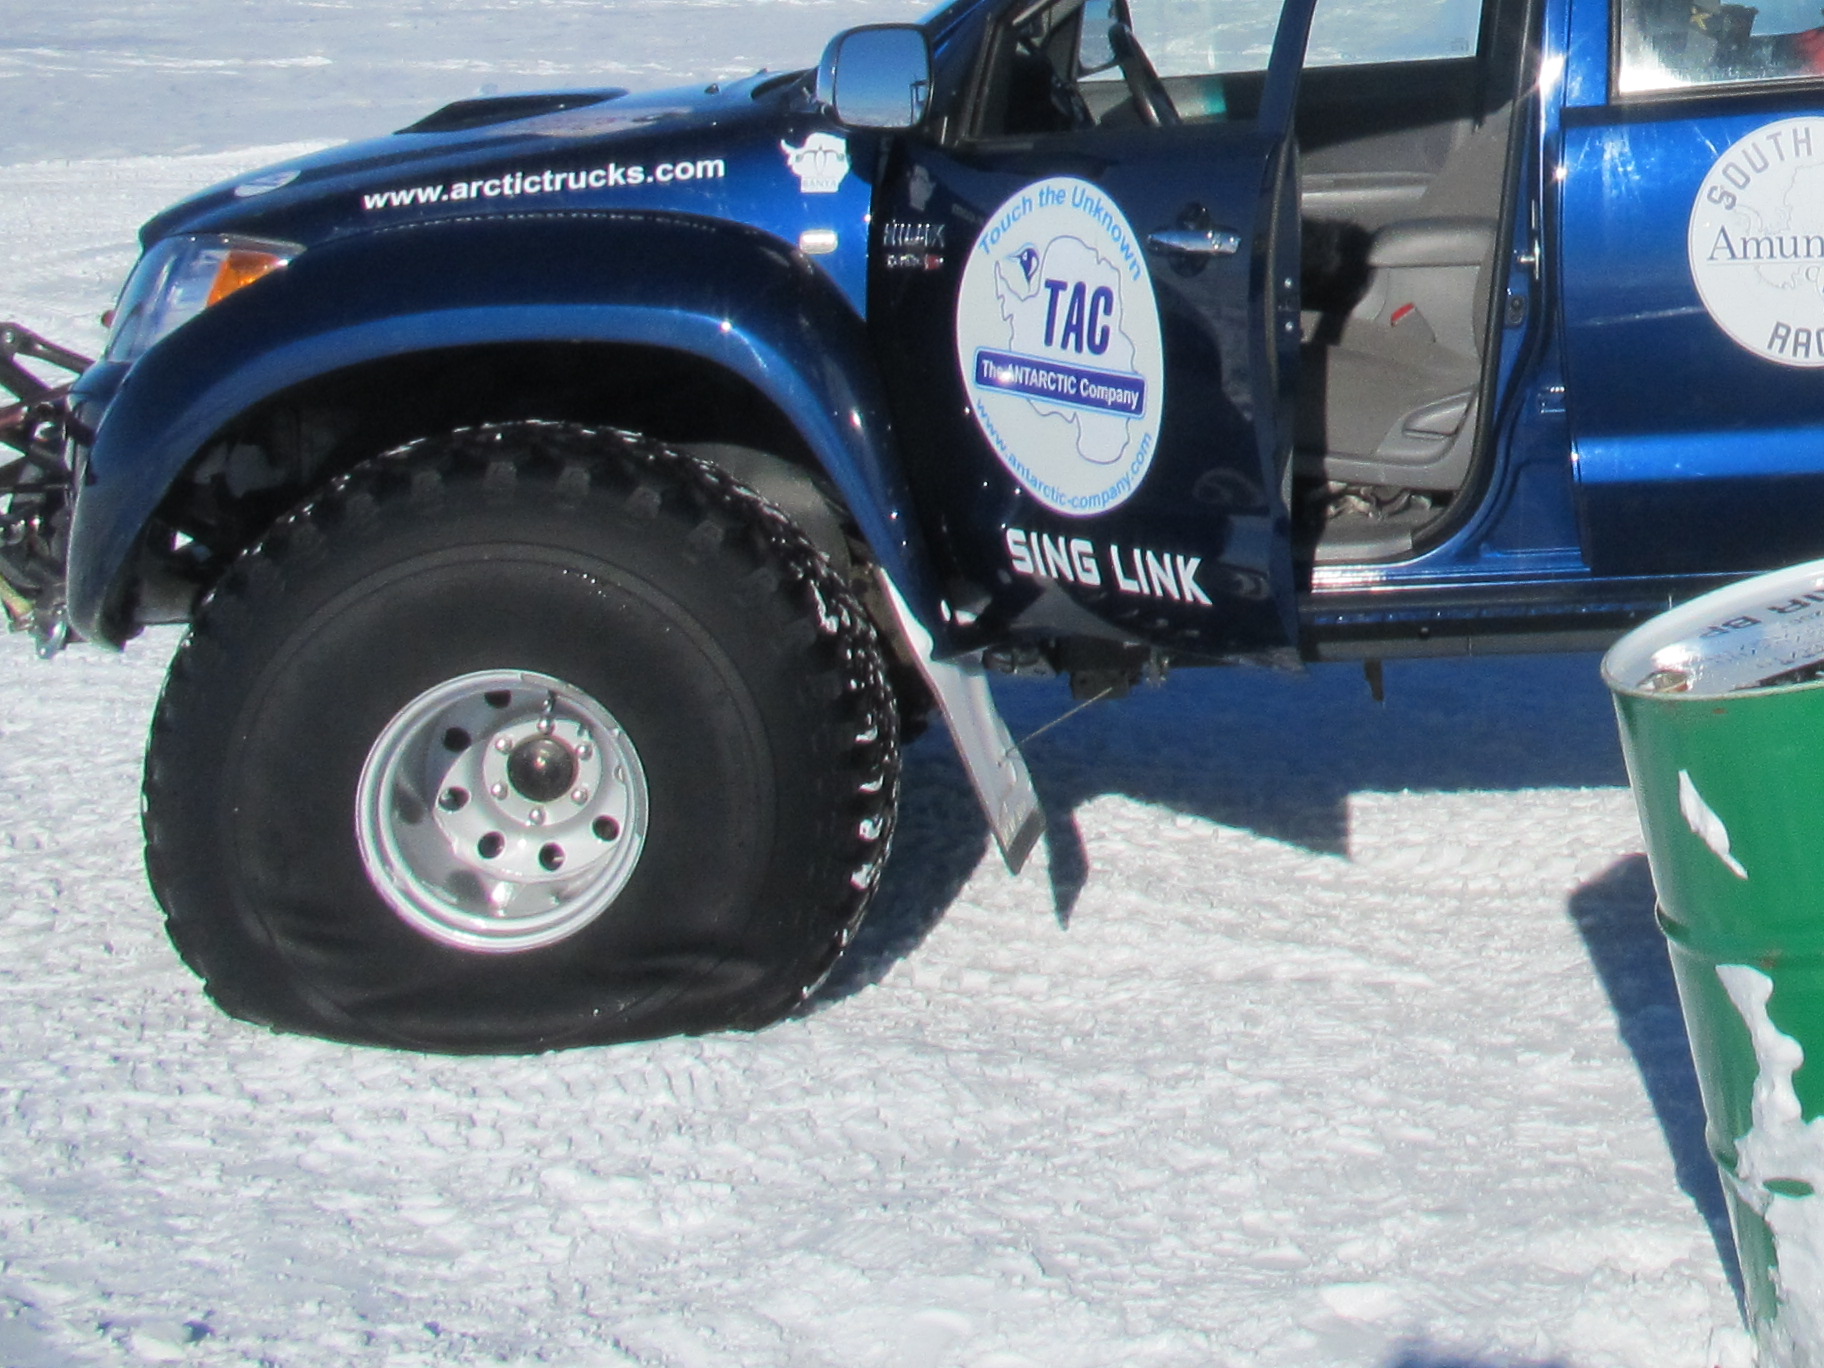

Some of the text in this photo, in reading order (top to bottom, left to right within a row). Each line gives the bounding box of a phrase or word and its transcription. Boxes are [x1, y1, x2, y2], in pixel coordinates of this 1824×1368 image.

[363, 158, 725, 210] www.arctictrucks.com
[1706, 127, 1813, 211] SOUTH
[978, 185, 1143, 282] Touch the Unknown
[1044, 278, 1114, 356] TAC
[982, 358, 1140, 411] The ANTARCTIC Company
[976, 398, 1152, 509] www.antarctic-company.com
[1006, 527, 1214, 607] SING LINK
[1700, 615, 1763, 639] BP
